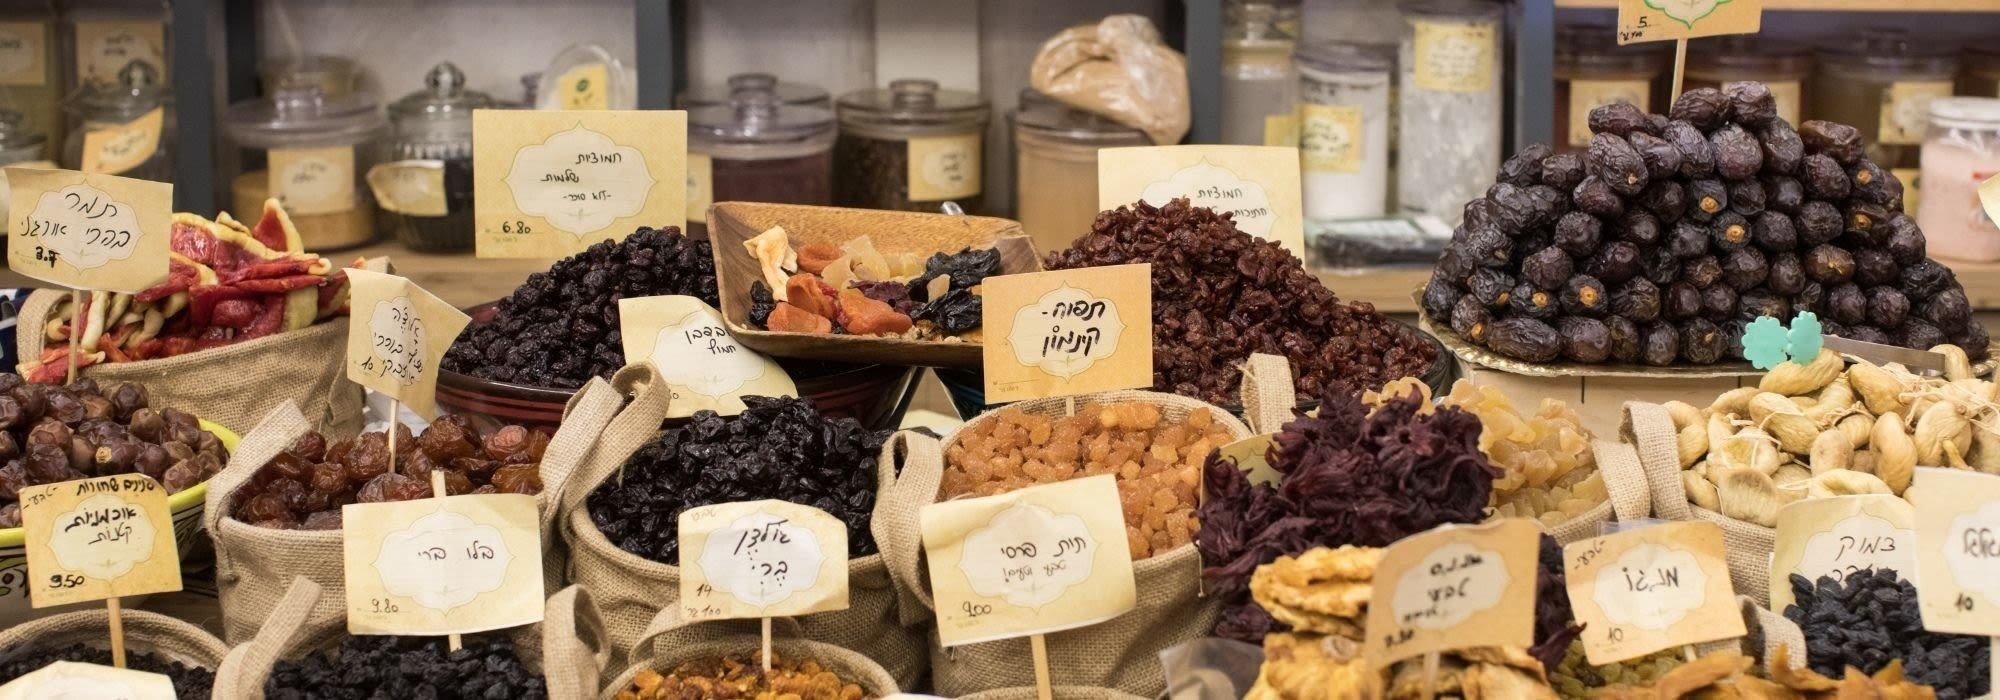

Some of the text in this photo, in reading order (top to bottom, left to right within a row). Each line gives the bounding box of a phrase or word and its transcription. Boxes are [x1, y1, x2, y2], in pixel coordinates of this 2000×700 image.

[575, 152, 622, 165] חמוציות
[65, 192, 118, 219] תמר
[20, 215, 67, 237] אורגני
[502, 221, 532, 235] 6.80
[707, 338, 736, 355] חמוץ
[418, 540, 495, 561] בלו ברי
[1001, 537, 1087, 558] תות פרסי
[1835, 535, 1896, 561] צמוק
[372, 598, 399, 613] 9.80
[1954, 592, 1974, 611] 10
[1607, 627, 1624, 643] 10
